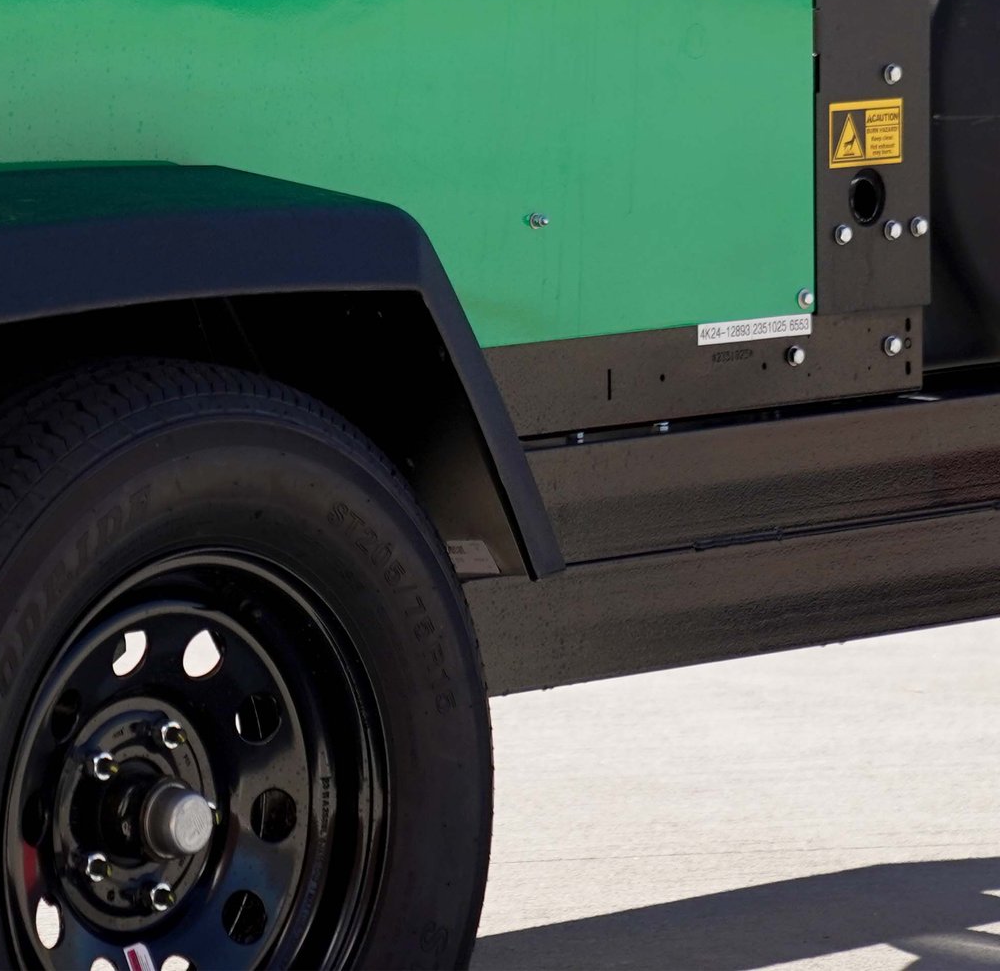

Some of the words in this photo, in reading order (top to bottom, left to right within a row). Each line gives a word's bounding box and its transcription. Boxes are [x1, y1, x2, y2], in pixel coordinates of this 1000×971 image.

[872, 113, 898, 123] CAUTION
[699, 324, 751, 341] 4K24-12893
[752, 320, 787, 335] 2351025
[789, 318, 809, 332] 6553
